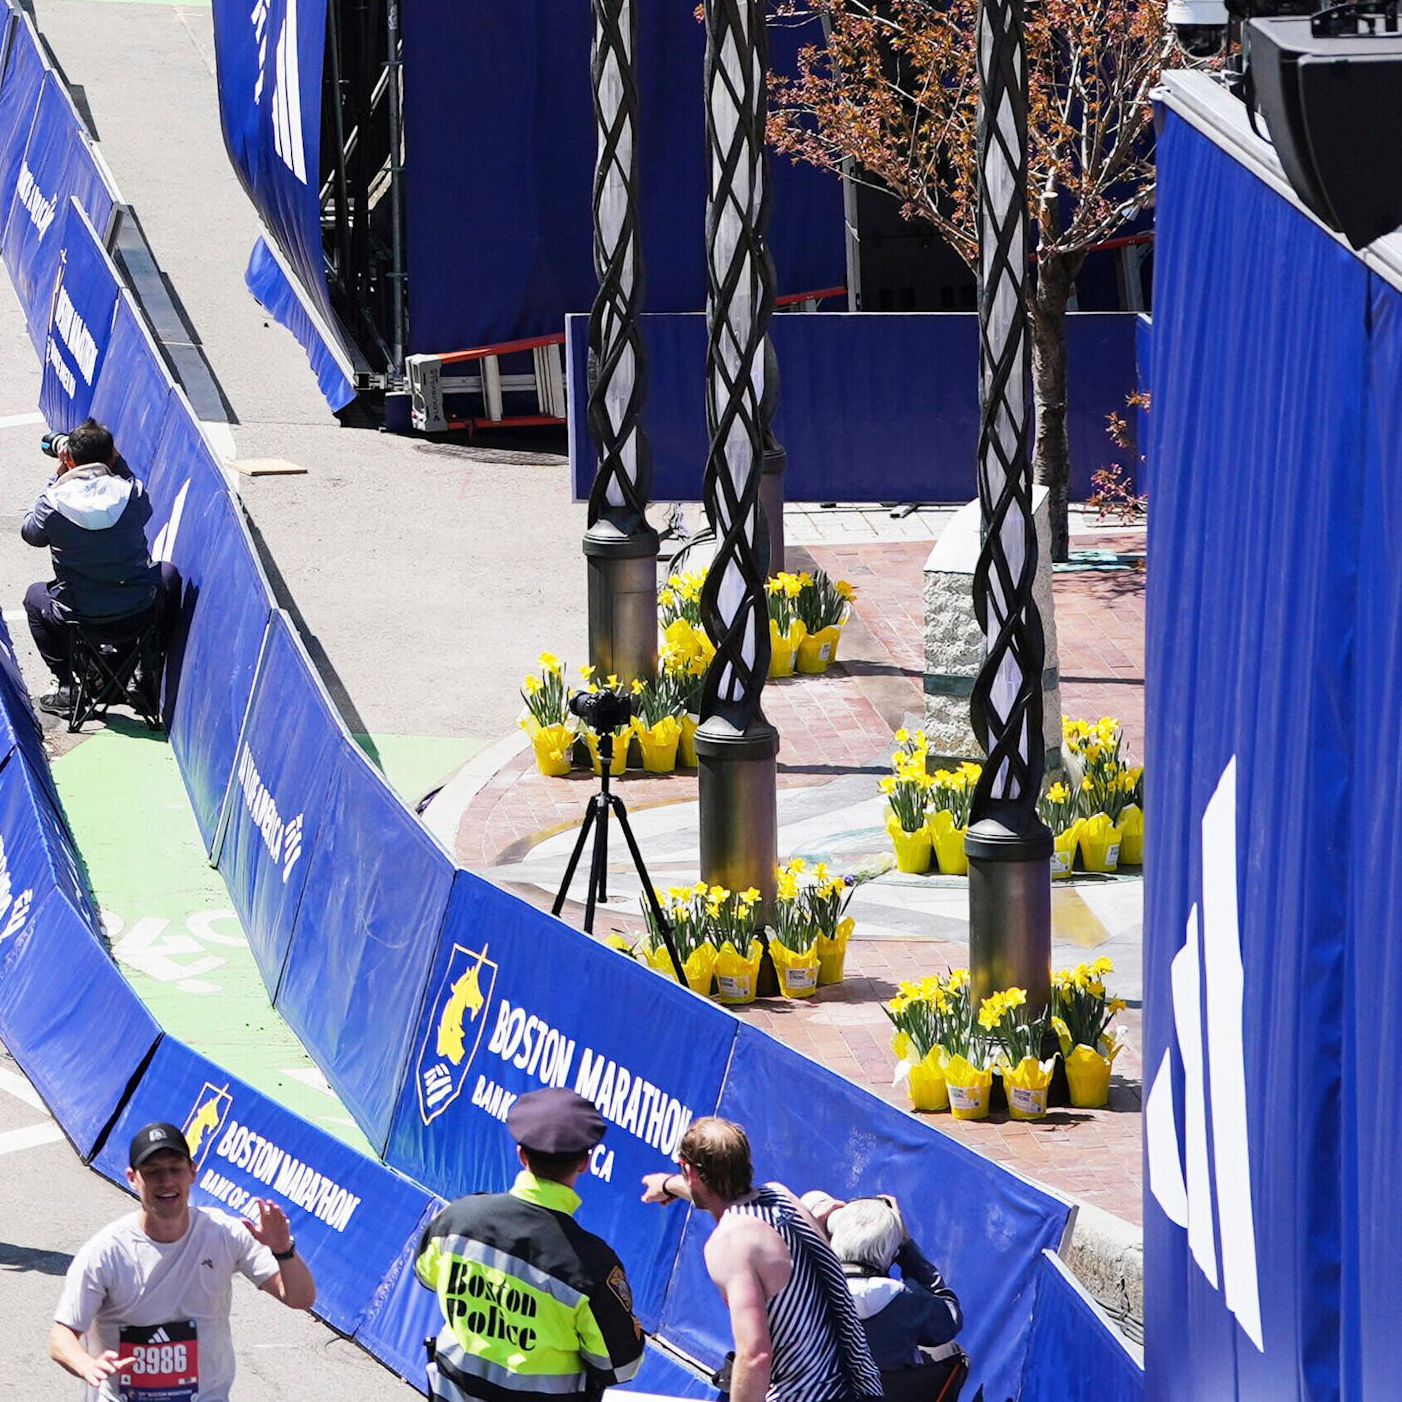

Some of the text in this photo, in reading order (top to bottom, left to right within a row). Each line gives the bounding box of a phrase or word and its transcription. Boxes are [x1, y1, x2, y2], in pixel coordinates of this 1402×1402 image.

[472, 1075, 517, 1124] BANK
[488, 999, 694, 1165] BOSTON MARATHON
[200, 1169, 249, 1212] BANK OF
[216, 1120, 360, 1233] BOSTON MARATHON
[447, 1261, 537, 1318] Boston
[446, 1298, 537, 1351] Police
[133, 1345, 187, 1374] 3986
